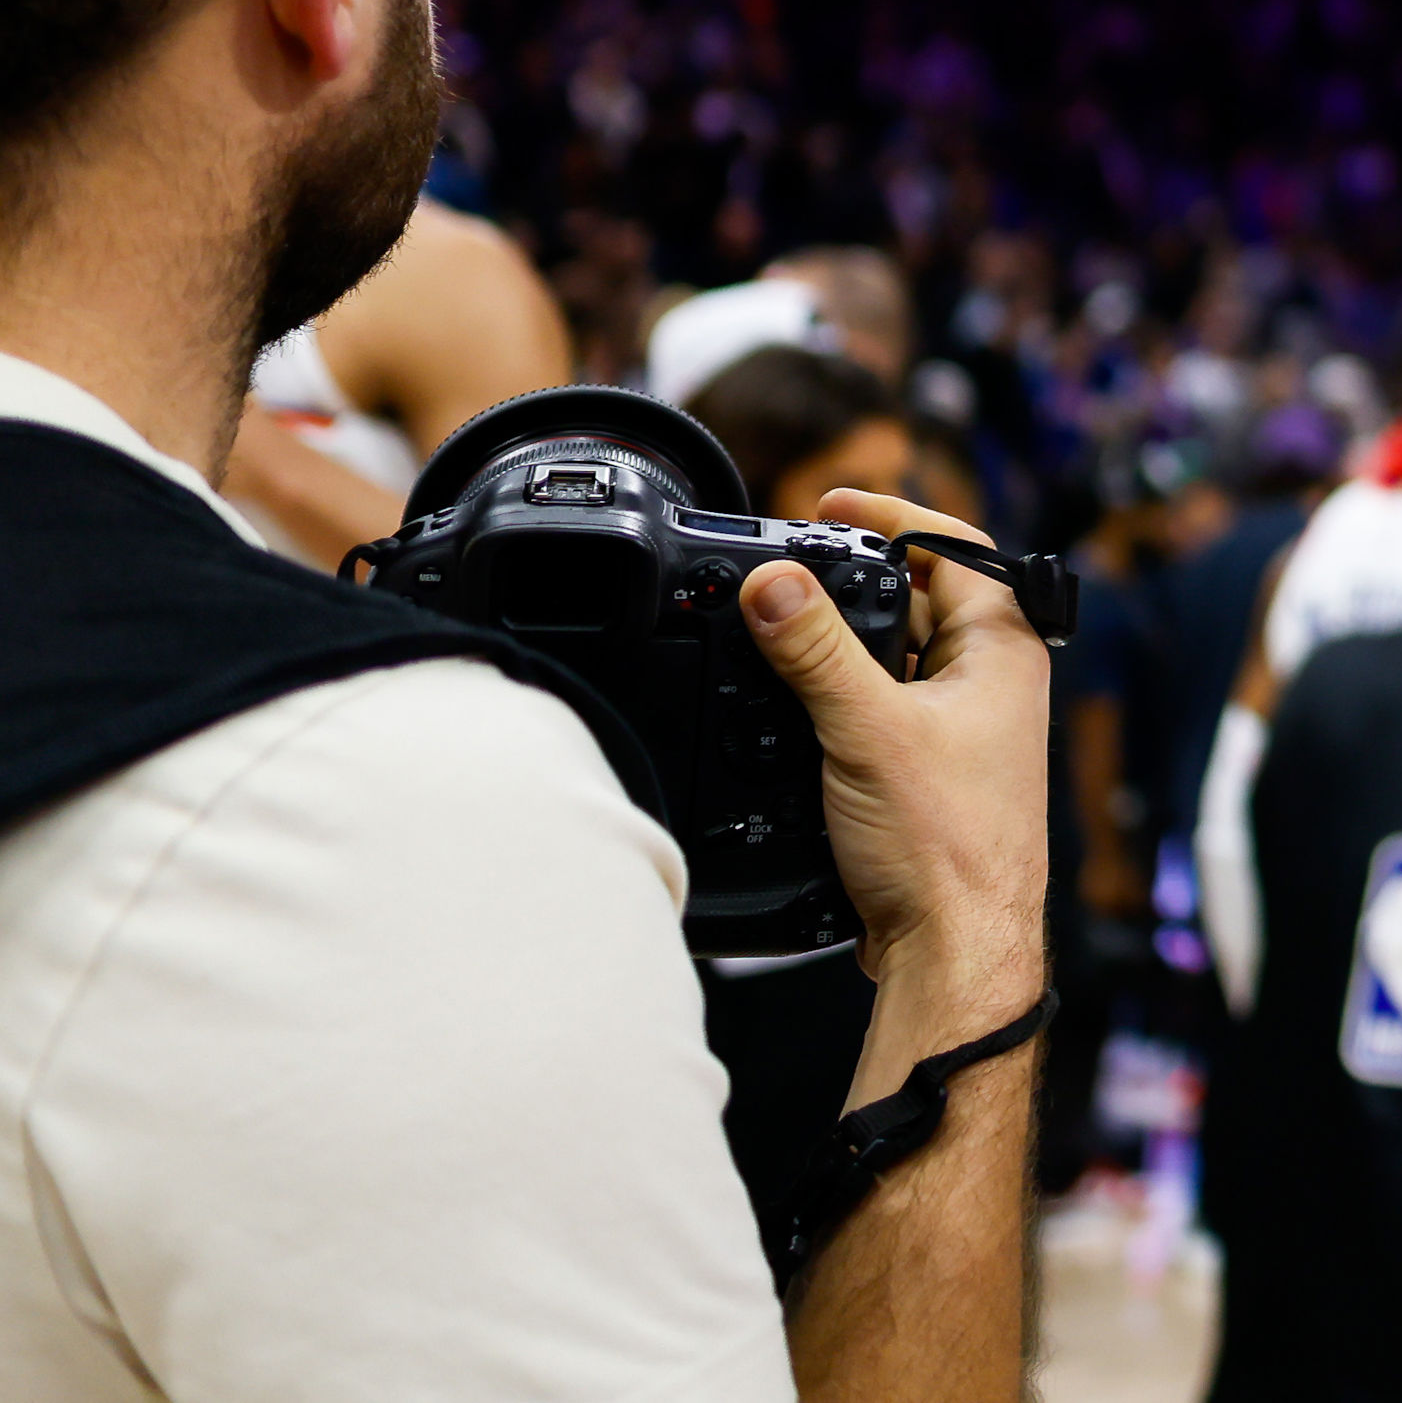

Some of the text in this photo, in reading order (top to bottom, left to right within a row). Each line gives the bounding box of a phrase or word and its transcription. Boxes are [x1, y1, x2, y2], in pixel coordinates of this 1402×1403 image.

[419, 573, 442, 582] MENU
[760, 736, 777, 746] SET
[748, 815, 763, 823] ON
[750, 825, 773, 833] LOCK
[746, 835, 764, 843] OFF
